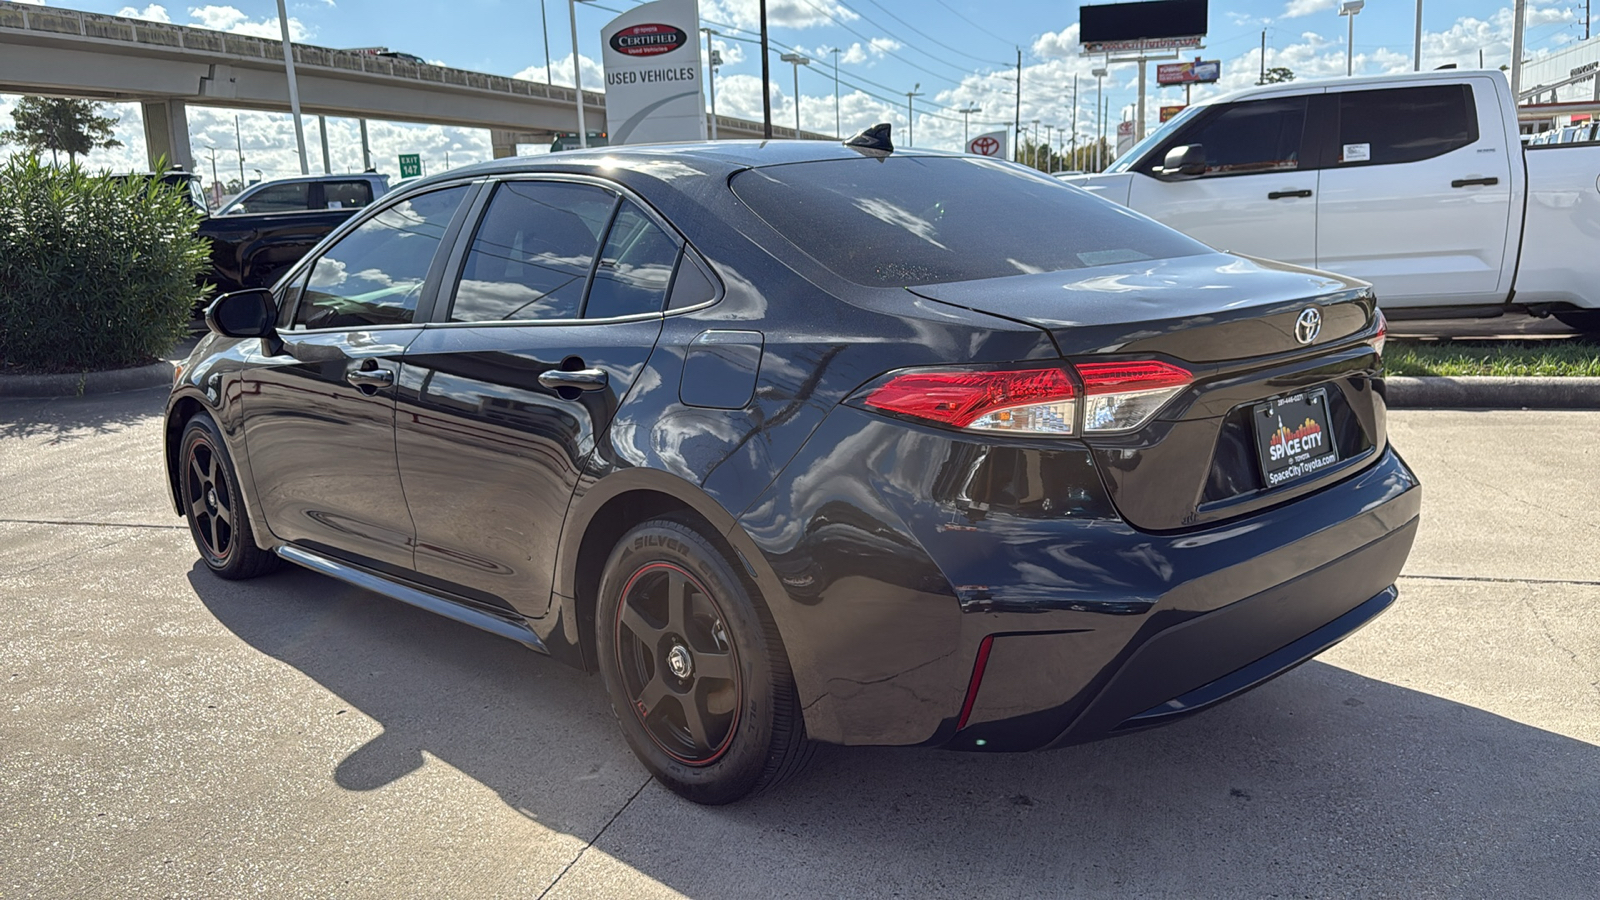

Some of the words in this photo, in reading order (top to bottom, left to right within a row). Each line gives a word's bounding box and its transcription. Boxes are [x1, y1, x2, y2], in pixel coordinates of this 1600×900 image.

[618, 34, 676, 47] CERTIFIED
[607, 71, 637, 85] USED
[639, 67, 694, 83] VEHICLES
[401, 156, 418, 164] EXIT
[403, 165, 418, 175] 147
[1269, 438, 1301, 461] SPACE
[1301, 431, 1322, 451] CITY
[1294, 453, 1311, 462] TOYOTA
[1269, 454, 1335, 485] SpaceCityToyota.com
[634, 534, 690, 557] SILVER
